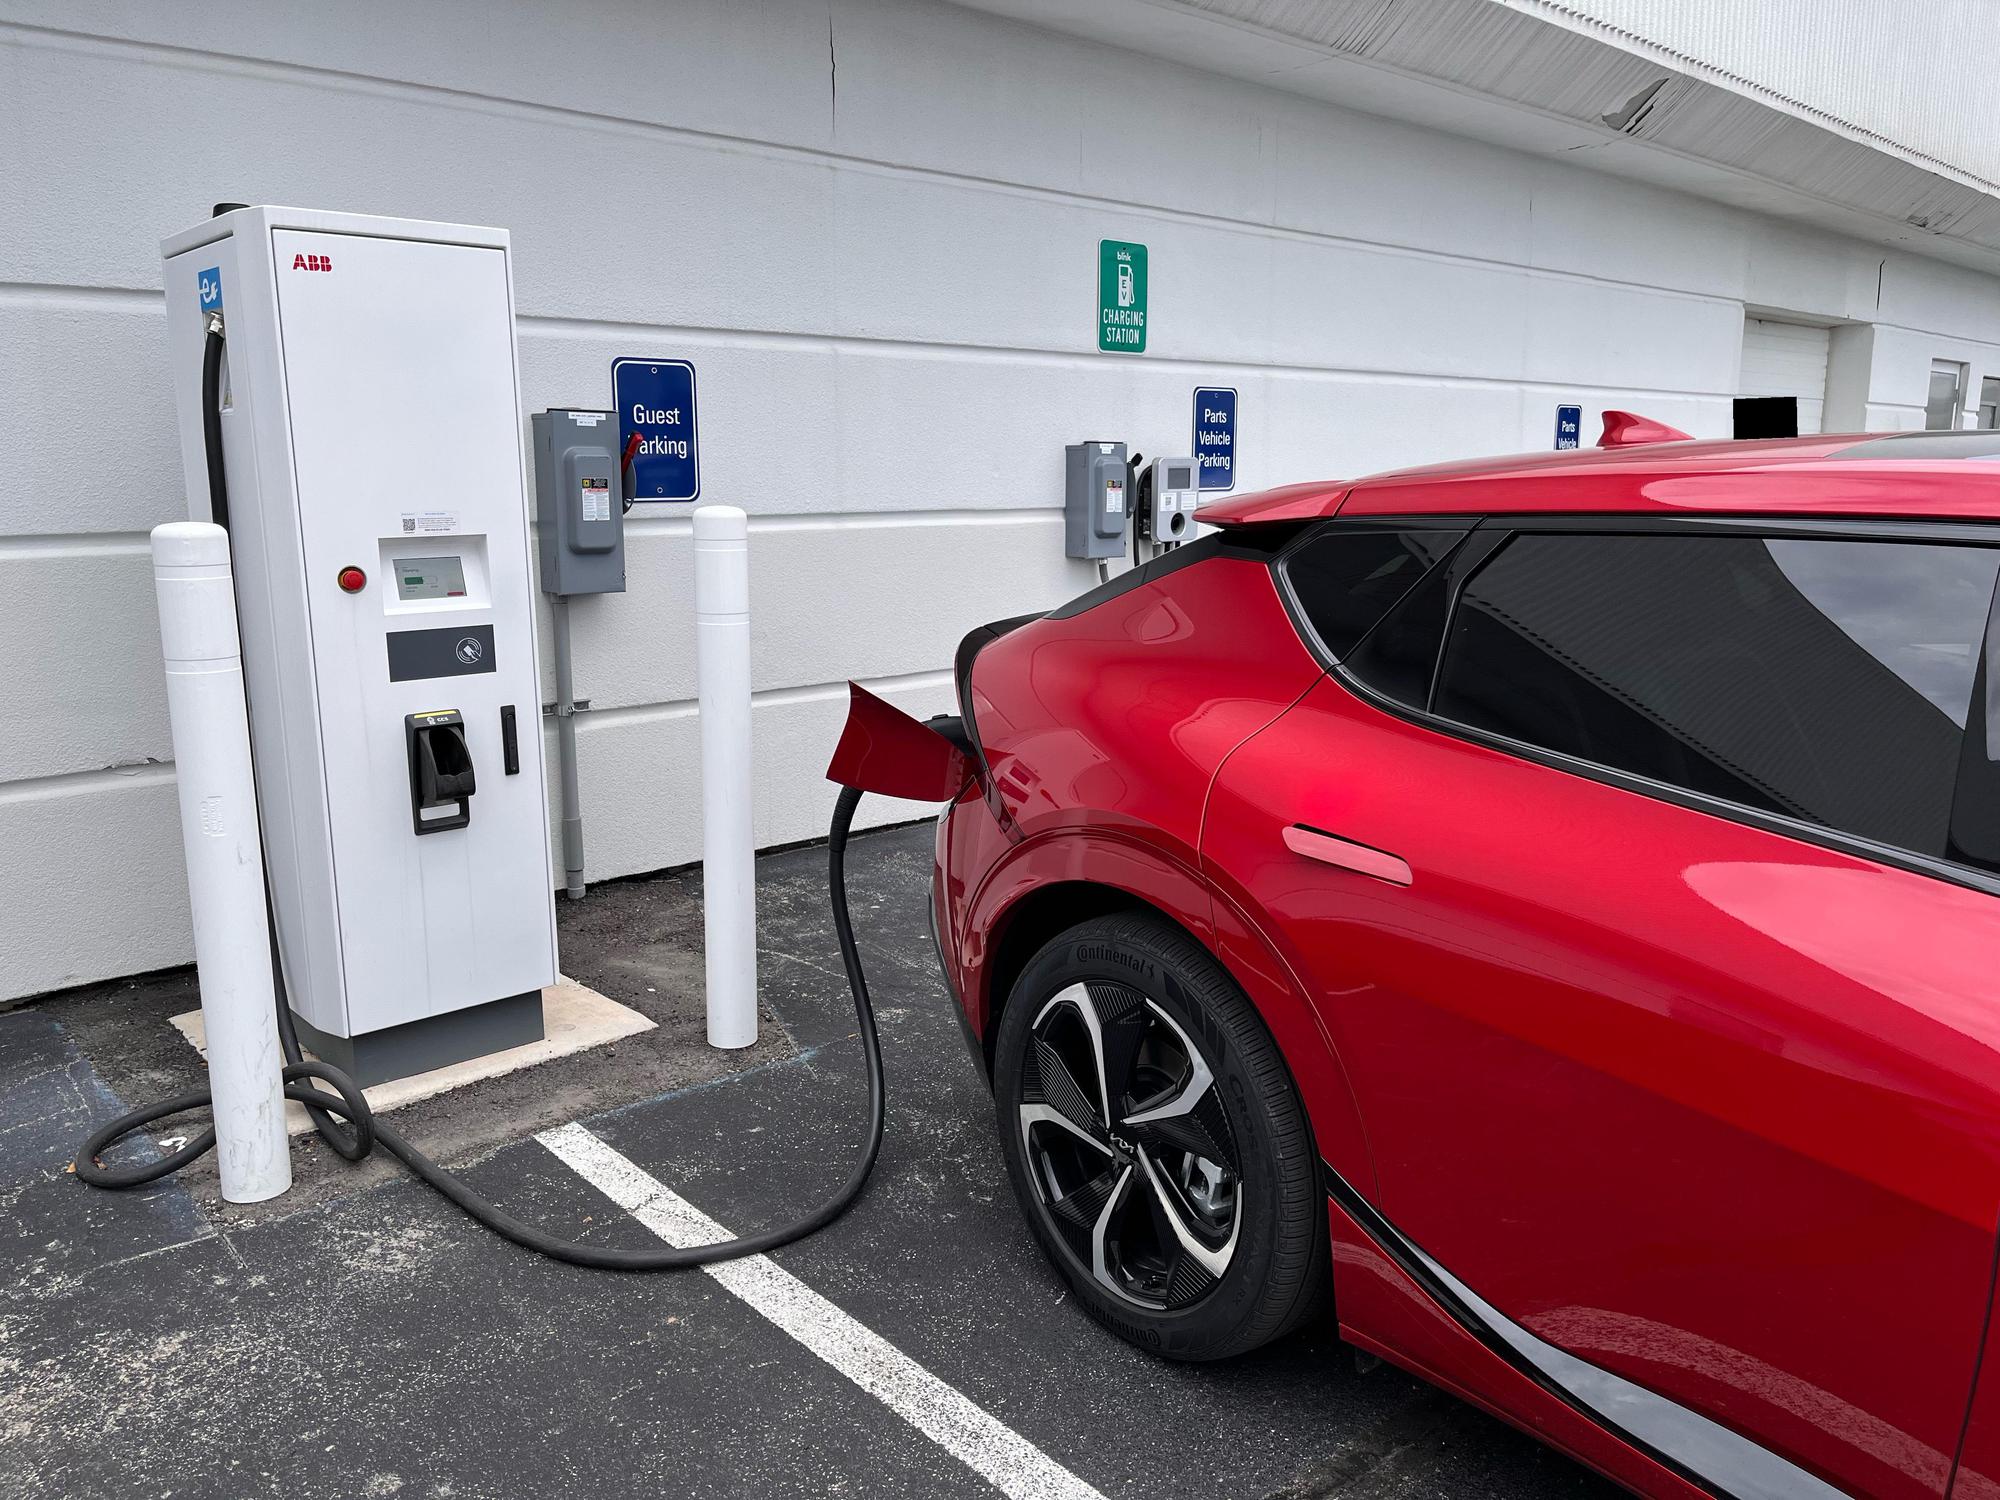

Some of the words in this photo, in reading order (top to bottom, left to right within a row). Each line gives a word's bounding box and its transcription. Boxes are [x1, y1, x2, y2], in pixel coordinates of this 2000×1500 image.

[293, 254, 332, 272] ABB
[1117, 251, 1132, 261] blink
[1103, 308, 1144, 327] CHARGING
[1106, 327, 1140, 344] STATION
[633, 404, 681, 425] Guest
[1204, 408, 1227, 423] Parts
[1561, 420, 1576, 433] Parts
[628, 435, 687, 459] arking
[1199, 430, 1231, 446] Vehicle
[1198, 452, 1230, 470] Parking
[1077, 944, 1145, 974] Continental
